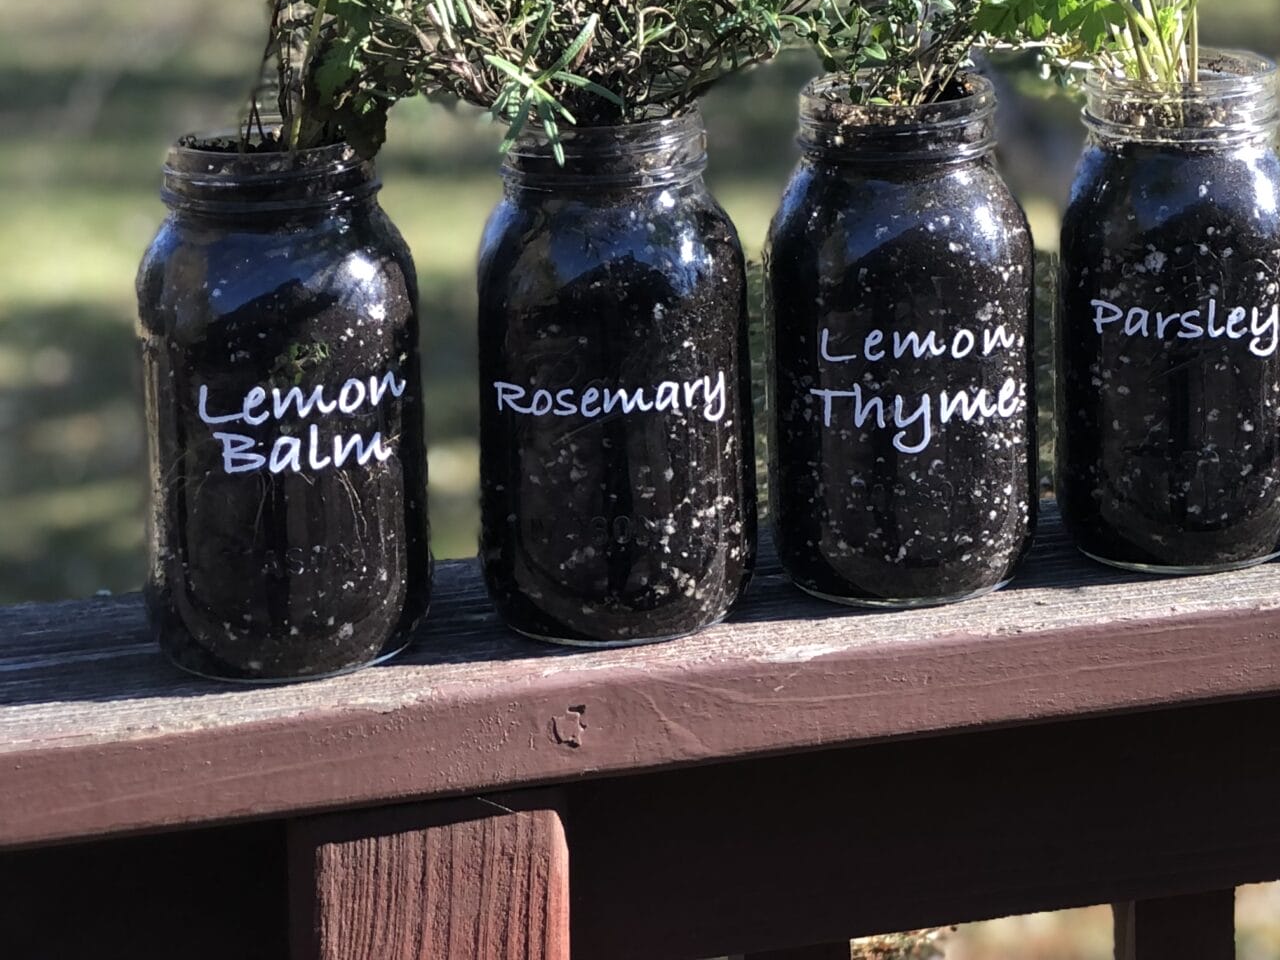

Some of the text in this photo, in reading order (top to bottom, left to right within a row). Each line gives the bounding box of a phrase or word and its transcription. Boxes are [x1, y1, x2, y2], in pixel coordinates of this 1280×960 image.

[820, 326, 1014, 362] Lemon
[1091, 299, 1280, 357] Parsley
[198, 372, 406, 426] Lemon
[493, 372, 725, 422] Rosemary
[810, 378, 1021, 453] Thyme
[214, 425, 393, 474] Balm
